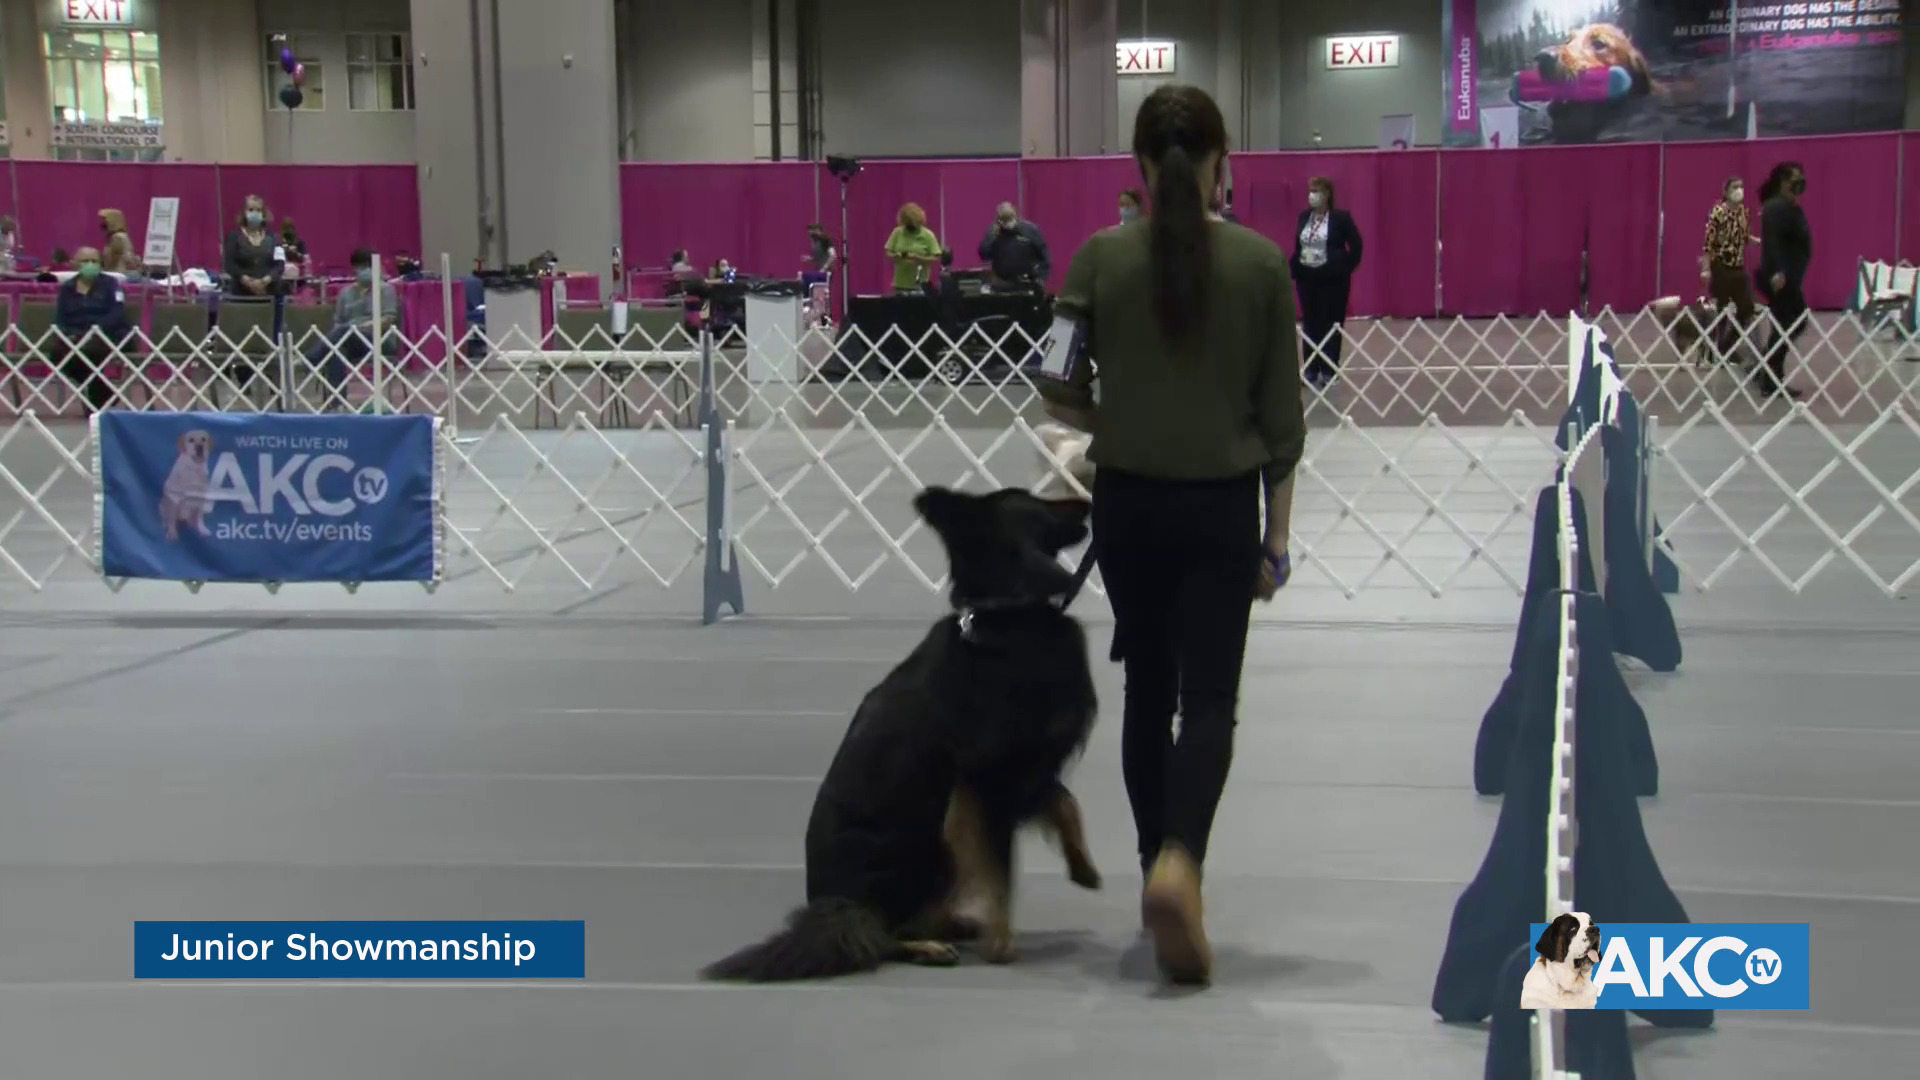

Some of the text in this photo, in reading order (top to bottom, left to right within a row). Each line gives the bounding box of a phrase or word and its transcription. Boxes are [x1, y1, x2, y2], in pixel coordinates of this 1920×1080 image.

[67, 0, 125, 20] EXIT
[1783, 3, 1807, 16] DOG
[1809, 2, 1832, 14] HAS
[1833, 1, 1855, 13] THE
[1781, 18, 1805, 31] DOG
[1806, 16, 1830, 29] HAS
[1831, 15, 1854, 28] THE
[1331, 40, 1393, 66] EXIT
[1458, 37, 1471, 121] Eukanuba
[65, 125, 160, 136] SOUTH CONCOURSE
[65, 136, 140, 146] INTERNATIONAL
[235, 435, 349, 449] WATCH LIVE ON
[203, 452, 357, 517] AKC
[216, 517, 373, 543] akc.tv/events
